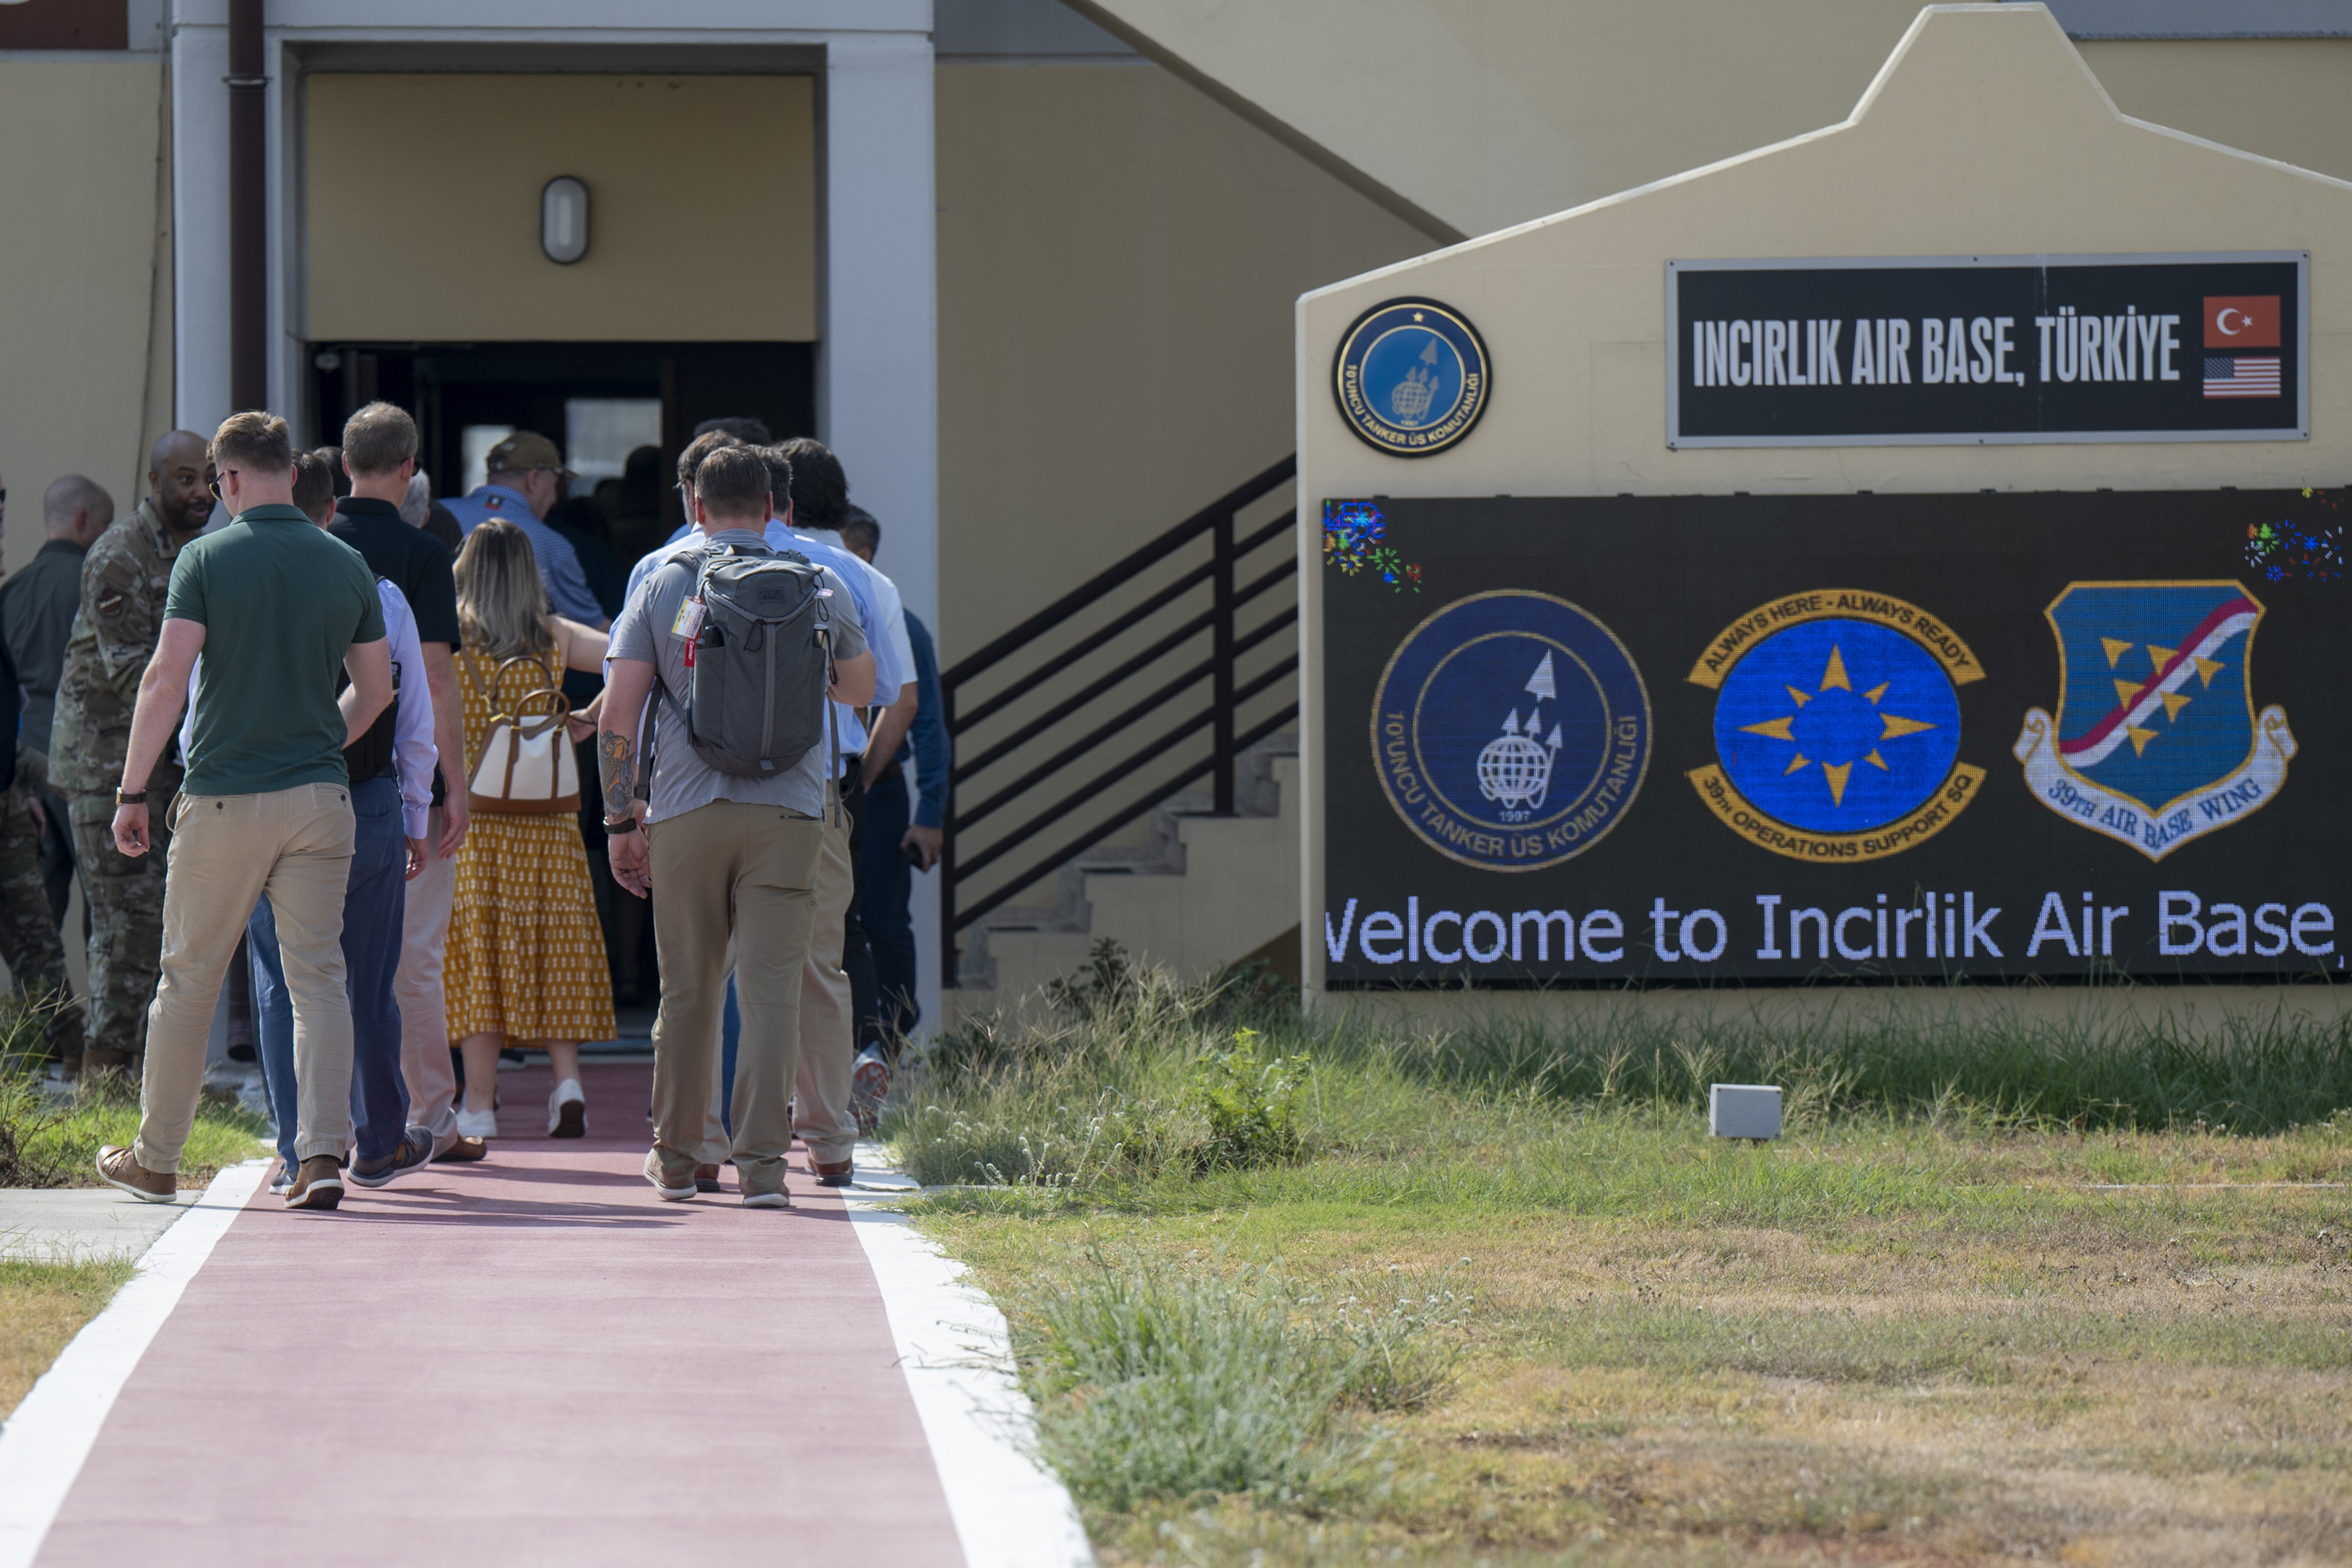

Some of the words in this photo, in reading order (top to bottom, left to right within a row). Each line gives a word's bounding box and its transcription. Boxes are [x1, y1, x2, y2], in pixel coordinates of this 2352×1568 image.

[1692, 318, 1842, 387] INCIRLIK
[1851, 317, 1912, 386] AIR
[1921, 316, 2026, 387] BASE,
[2035, 306, 2181, 382] TÜRKİYE
[1361, 412, 1407, 445] TANKER
[1409, 432, 1427, 446] ÜS
[1705, 612, 1769, 673] ALWAYS
[1769, 595, 1823, 623] HERE
[1836, 594, 1914, 624] ALWAYS
[1913, 617, 1971, 669] READY
[1420, 801, 1504, 857] TANKER
[1511, 833, 1544, 857] ÜS
[1547, 716, 1638, 849] KOMUTANLIĞI
[1733, 811, 1858, 857] OPERATIONS
[1863, 802, 1951, 854] SUPPORT
[1949, 774, 1973, 803] SQ
[2098, 805, 2138, 836] AIR
[2143, 809, 2193, 850] BASE
[2199, 778, 2263, 820] WING
[1648, 896, 1728, 963] to
[1756, 891, 2005, 961] Incirlik
[2026, 891, 2130, 958] Air
